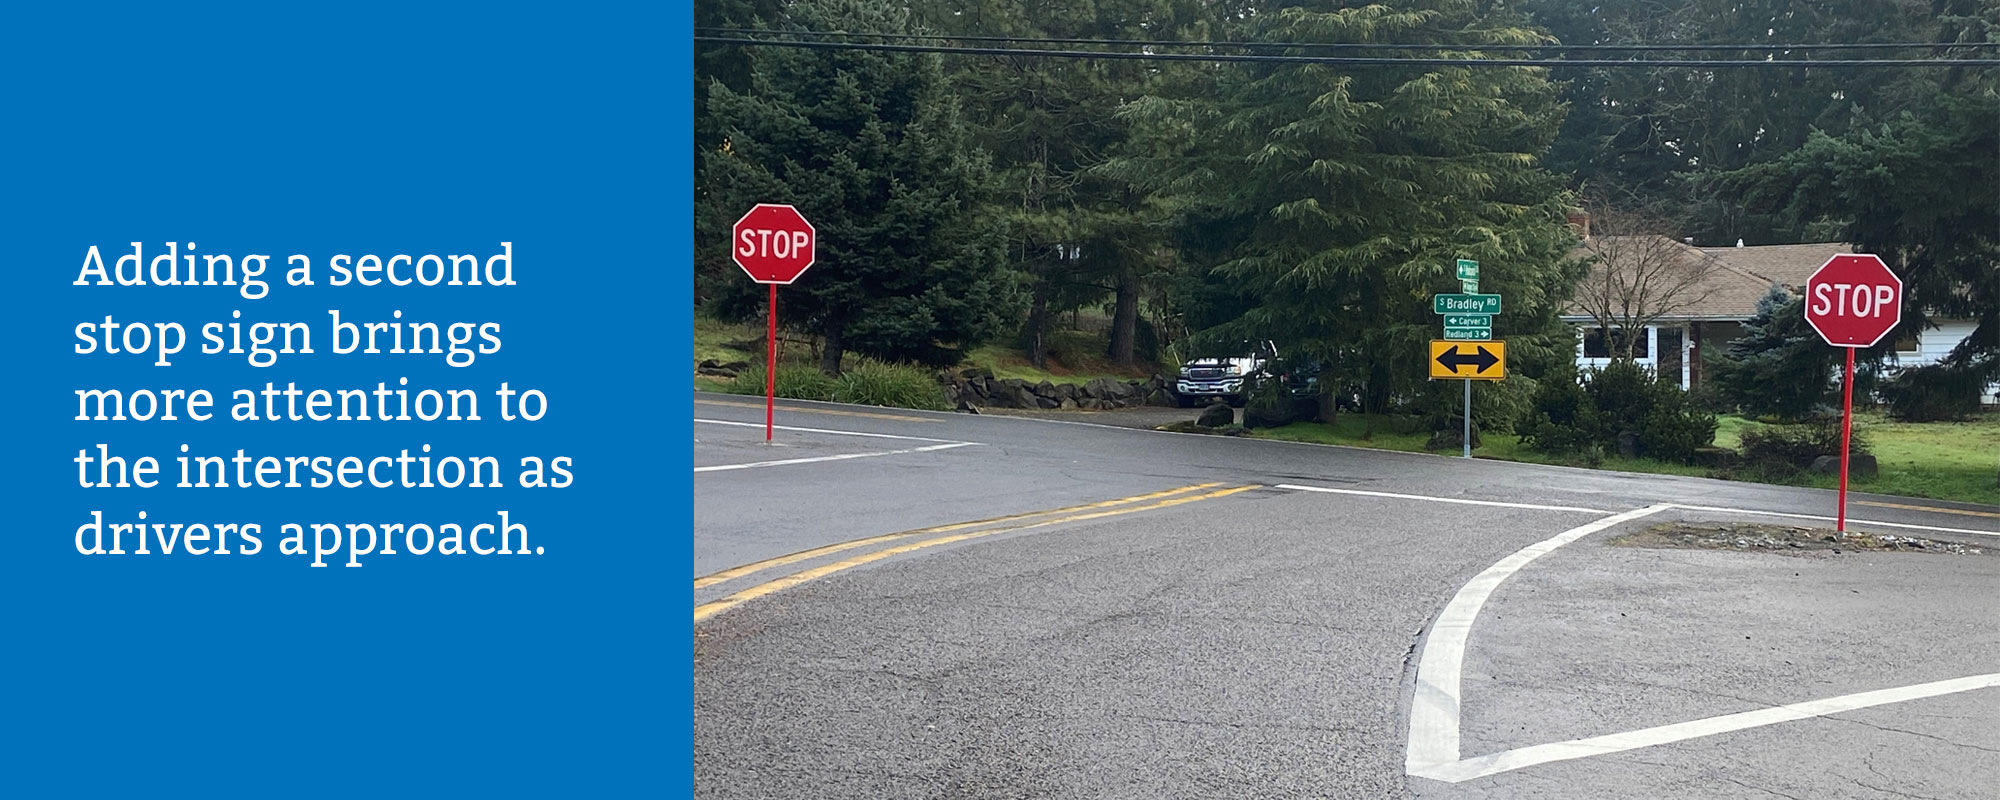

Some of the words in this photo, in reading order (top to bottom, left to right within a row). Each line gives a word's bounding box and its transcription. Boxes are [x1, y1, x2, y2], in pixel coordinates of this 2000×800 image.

[739, 228, 809, 259] STOP
[1440, 298, 1445, 306] S
[1447, 298, 1484, 311] Bradley
[1486, 298, 1497, 306] RD
[1812, 282, 1894, 317] STOP
[1458, 317, 1481, 325] Carver
[1482, 318, 1487, 326] 3
[1446, 330, 1473, 338] Redland
[1474, 330, 1479, 338] 3
